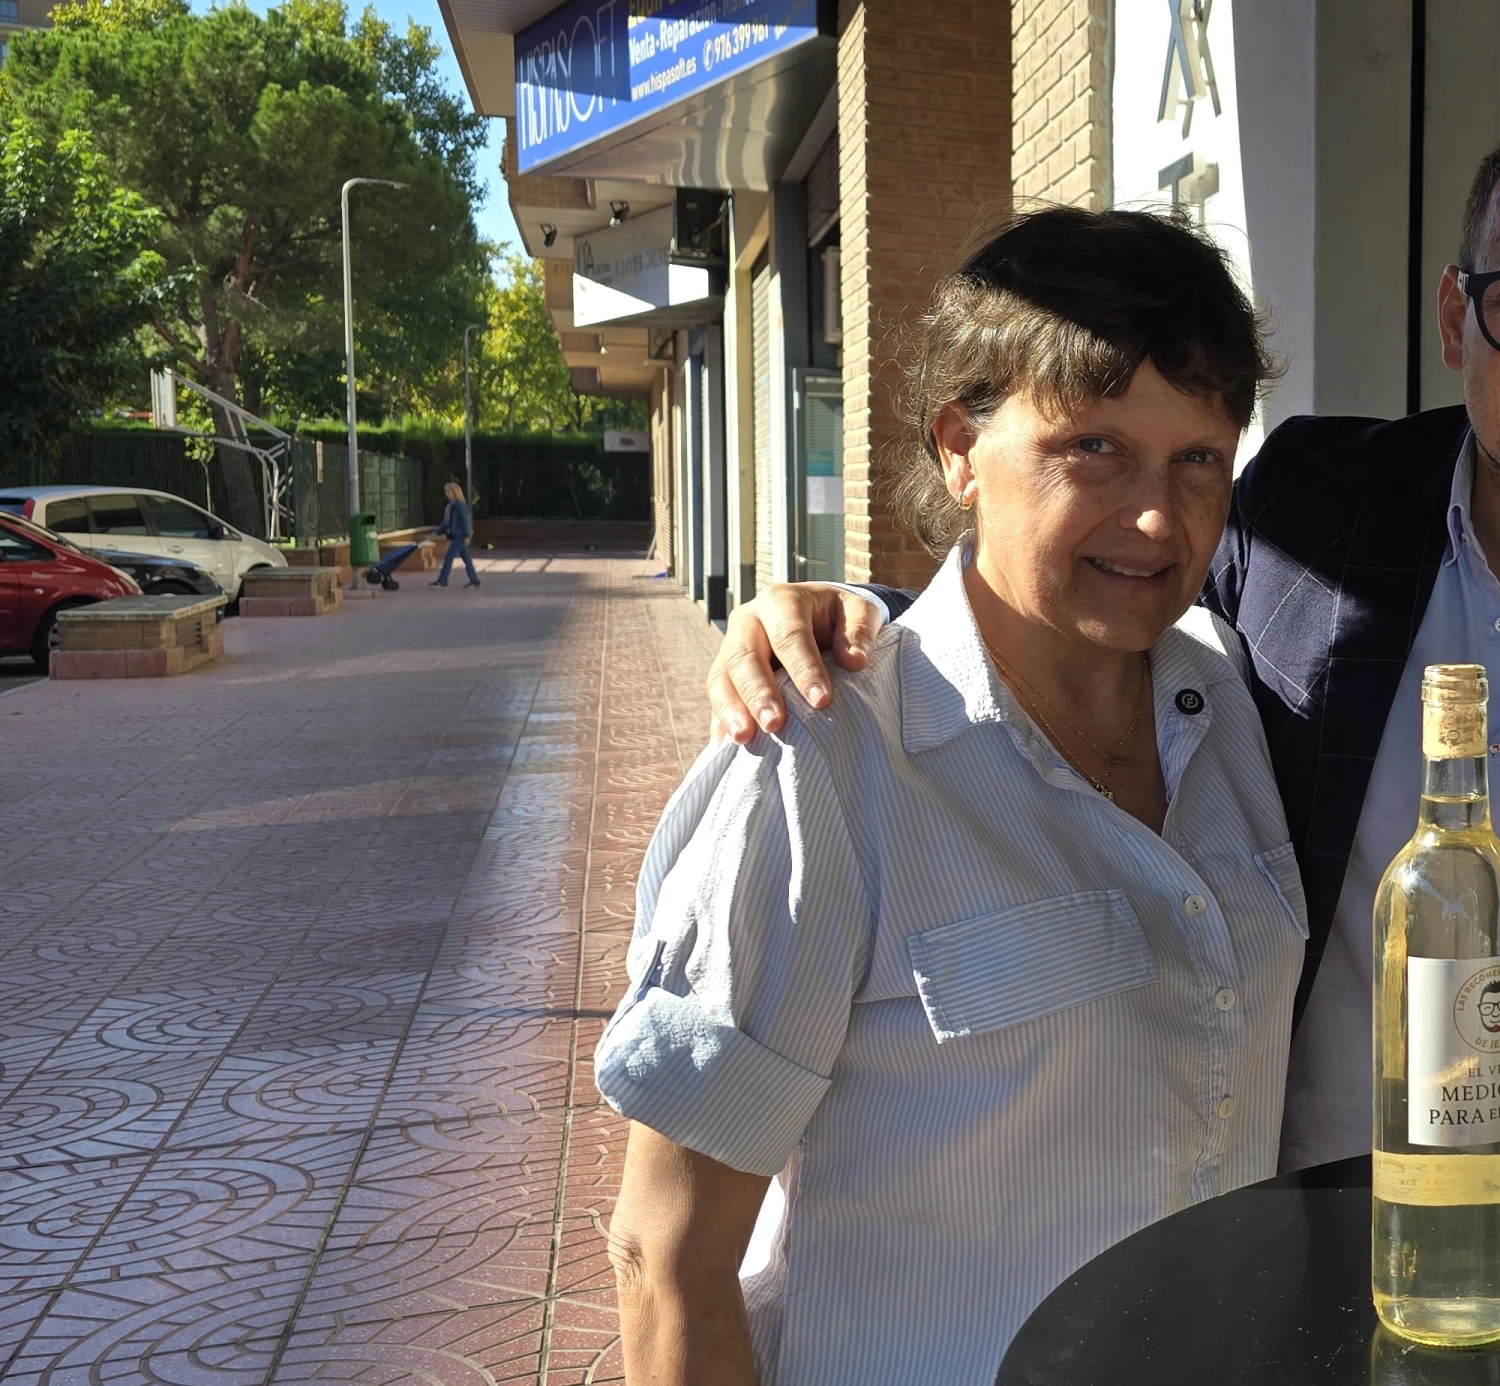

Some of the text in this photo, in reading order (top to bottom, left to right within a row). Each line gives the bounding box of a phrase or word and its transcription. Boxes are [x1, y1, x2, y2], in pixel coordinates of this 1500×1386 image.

[629, 32, 656, 67] Venta
[519, 0, 617, 149] HISPASOFT
[631, 55, 697, 102] www.hispasoft.es
[1457, 991, 1467, 1011] LAS
[1474, 1037, 1488, 1048] DE
[1468, 1066, 1484, 1078] EL
[1429, 1107, 1484, 1125] PARA
